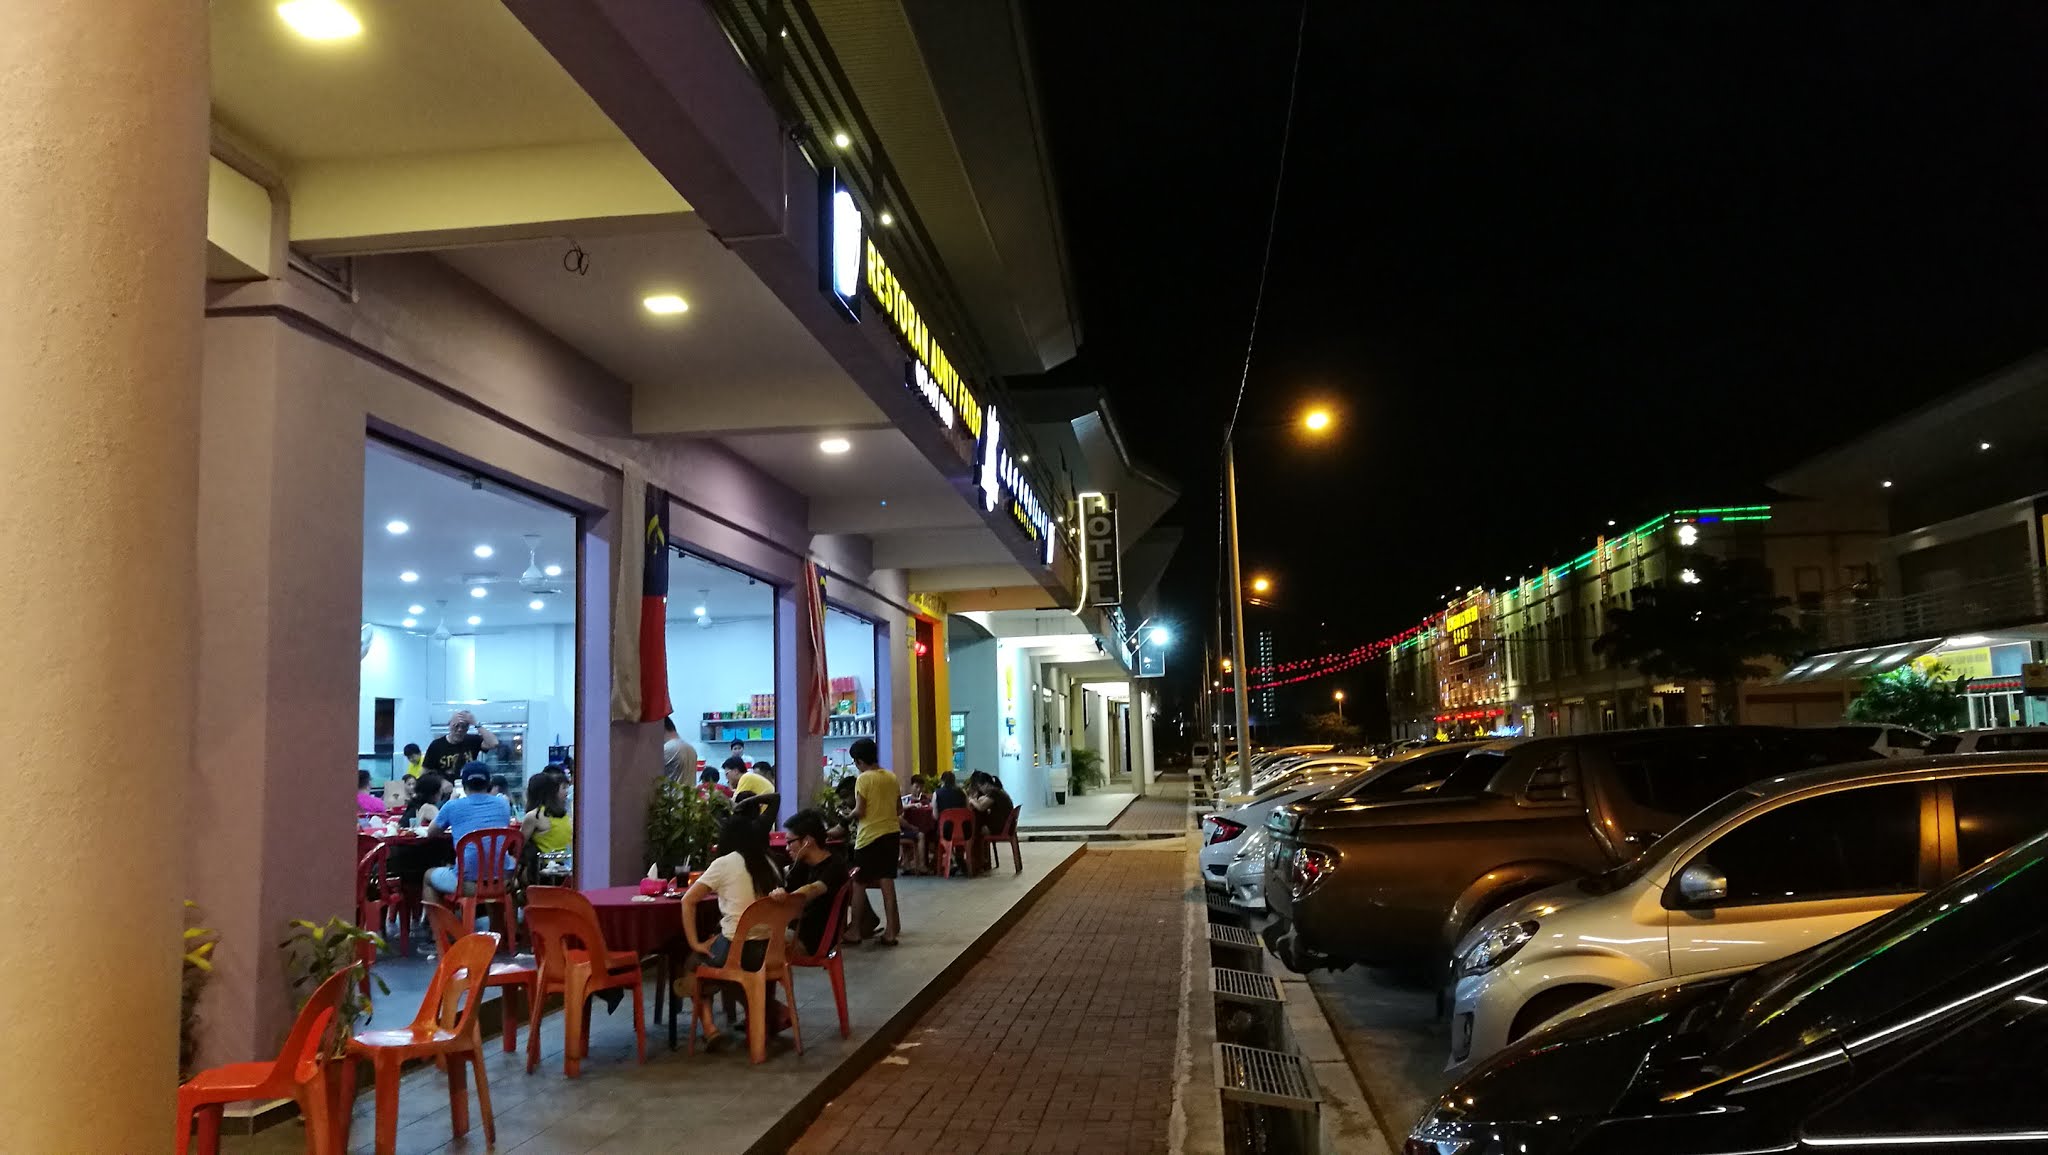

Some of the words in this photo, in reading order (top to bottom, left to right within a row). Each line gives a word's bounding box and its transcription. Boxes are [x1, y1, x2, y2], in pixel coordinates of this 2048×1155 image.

[867, 236, 929, 365] RESTORAN
[930, 336, 959, 406] AUNTY
[1086, 496, 1114, 603] HOTEL
